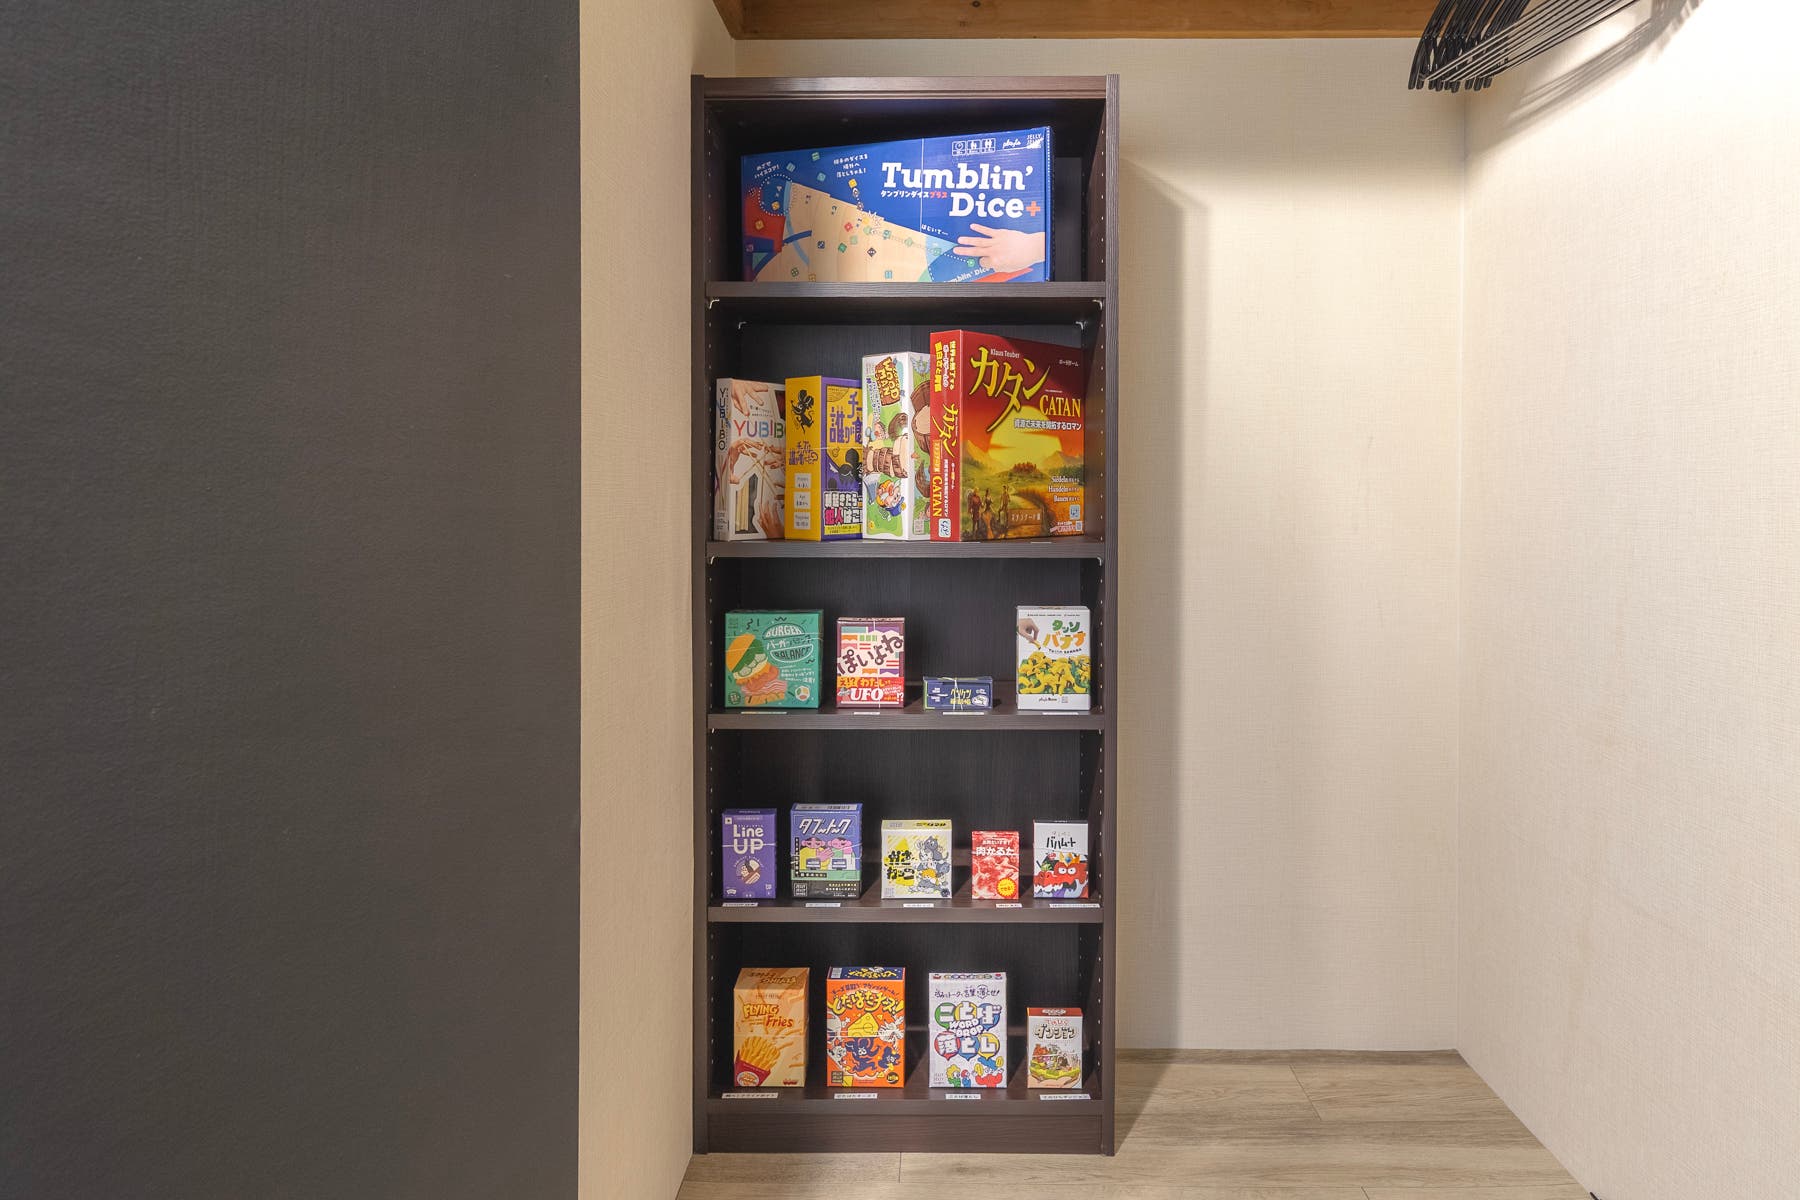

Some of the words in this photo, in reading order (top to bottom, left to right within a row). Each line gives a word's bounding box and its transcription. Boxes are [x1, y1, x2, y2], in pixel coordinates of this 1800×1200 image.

[881, 162, 1034, 191] Tumblin'
[990, 348, 1004, 357] Klaus
[969, 346, 1051, 432] カタン
[1040, 394, 1081, 418] CATAN
[718, 387, 726, 451] YUBIBO
[733, 419, 786, 439] YUBIB
[931, 403, 959, 458] カタン
[932, 475, 943, 517] CATAN
[765, 624, 803, 638] BURGER
[850, 687, 884, 701] UFO
[733, 824, 764, 838] Line
[733, 838, 764, 854] UP
[975, 846, 1015, 857] 肉かるた
[743, 1003, 780, 1019] FLYING
[940, 1001, 1002, 1025] ことば
[765, 1014, 794, 1028] Fries
[949, 1018, 980, 1030] WORD
[956, 1025, 984, 1038] DROP
